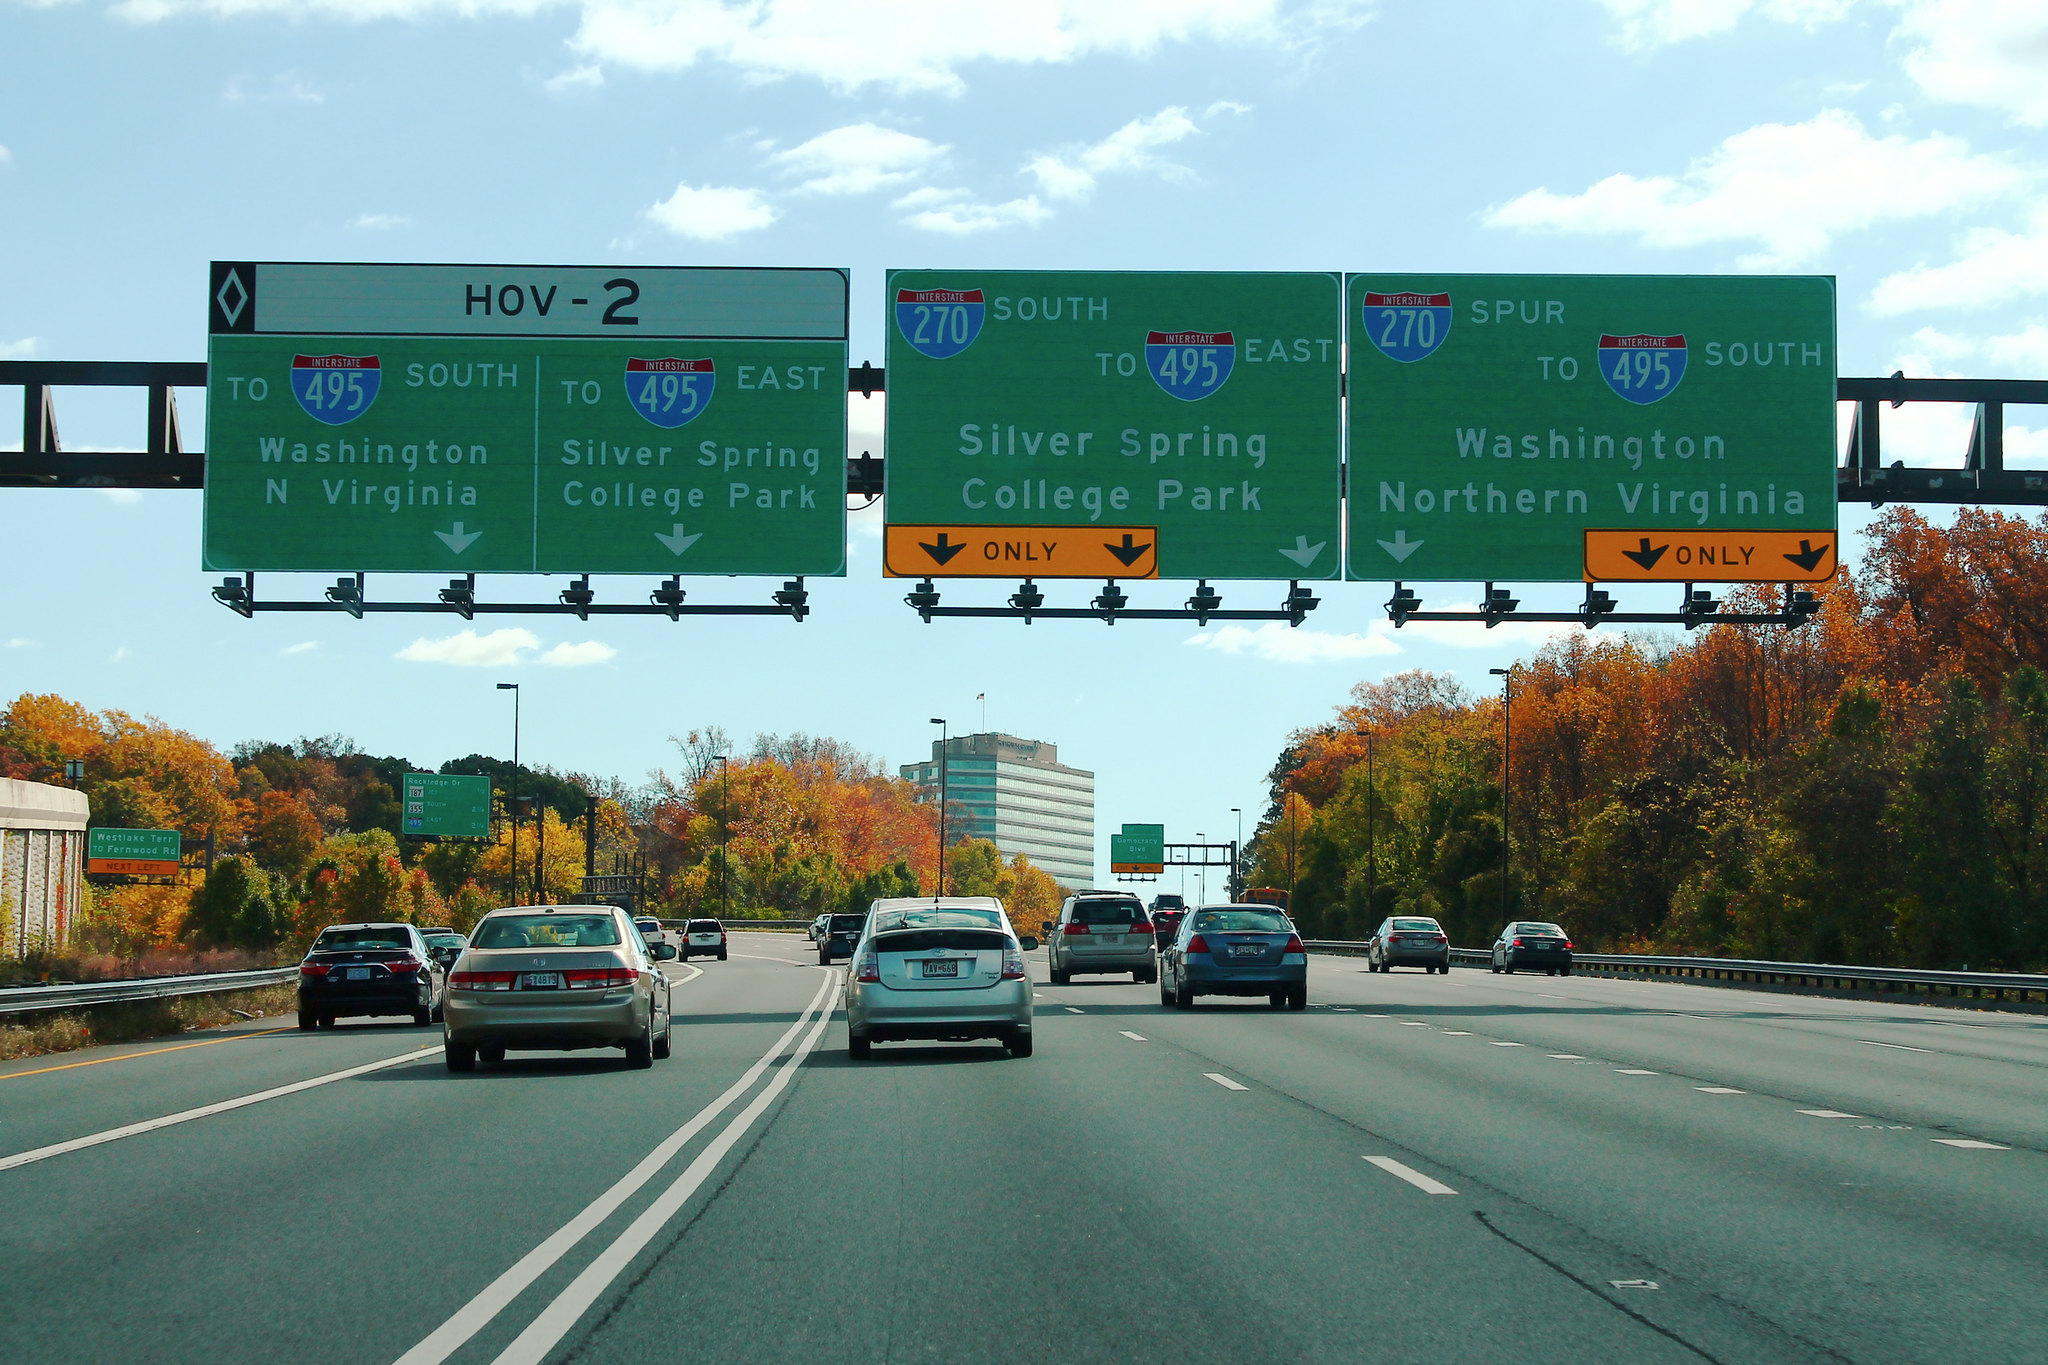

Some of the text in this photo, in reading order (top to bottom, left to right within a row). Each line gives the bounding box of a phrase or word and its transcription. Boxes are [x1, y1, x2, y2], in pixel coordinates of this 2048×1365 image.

[465, 277, 641, 326] HOV-2
[915, 292, 965, 302] INTERSTATE
[1382, 296, 1432, 306] INTERSTATE
[913, 296, 1108, 345] 270 SOUTH
[1380, 300, 1565, 348] 270 SPUR
[1165, 334, 1215, 344] INTERSTATE
[1618, 338, 1668, 348] INTERSTATE
[311, 357, 361, 368] INTERSTATE
[645, 360, 695, 371] INTERSTATE
[1096, 338, 1333, 388] TO 495 EAST
[1537, 342, 1822, 390] TO 495 SOUTH
[227, 363, 518, 411] TO 495 SOUTH
[560, 365, 826, 414] TO 495 EAST
[259, 437, 488, 472] Washington
[561, 440, 821, 475] Silver Spring
[959, 424, 1267, 469] Silver Spring
[1456, 426, 1725, 471] Washington
[265, 480, 478, 513] N Virginia
[562, 481, 817, 516] College Park
[962, 478, 1261, 522] College Park
[1379, 481, 1805, 525] Northern Virginia
[983, 542, 1057, 561] ONLY
[1676, 546, 1756, 565] ONLY
[97, 833, 173, 842] Westlake Terr
[107, 846, 157, 854] Fernwood
[163, 847, 176, 855] Rd
[107, 863, 161, 871] NEXT LEFT
